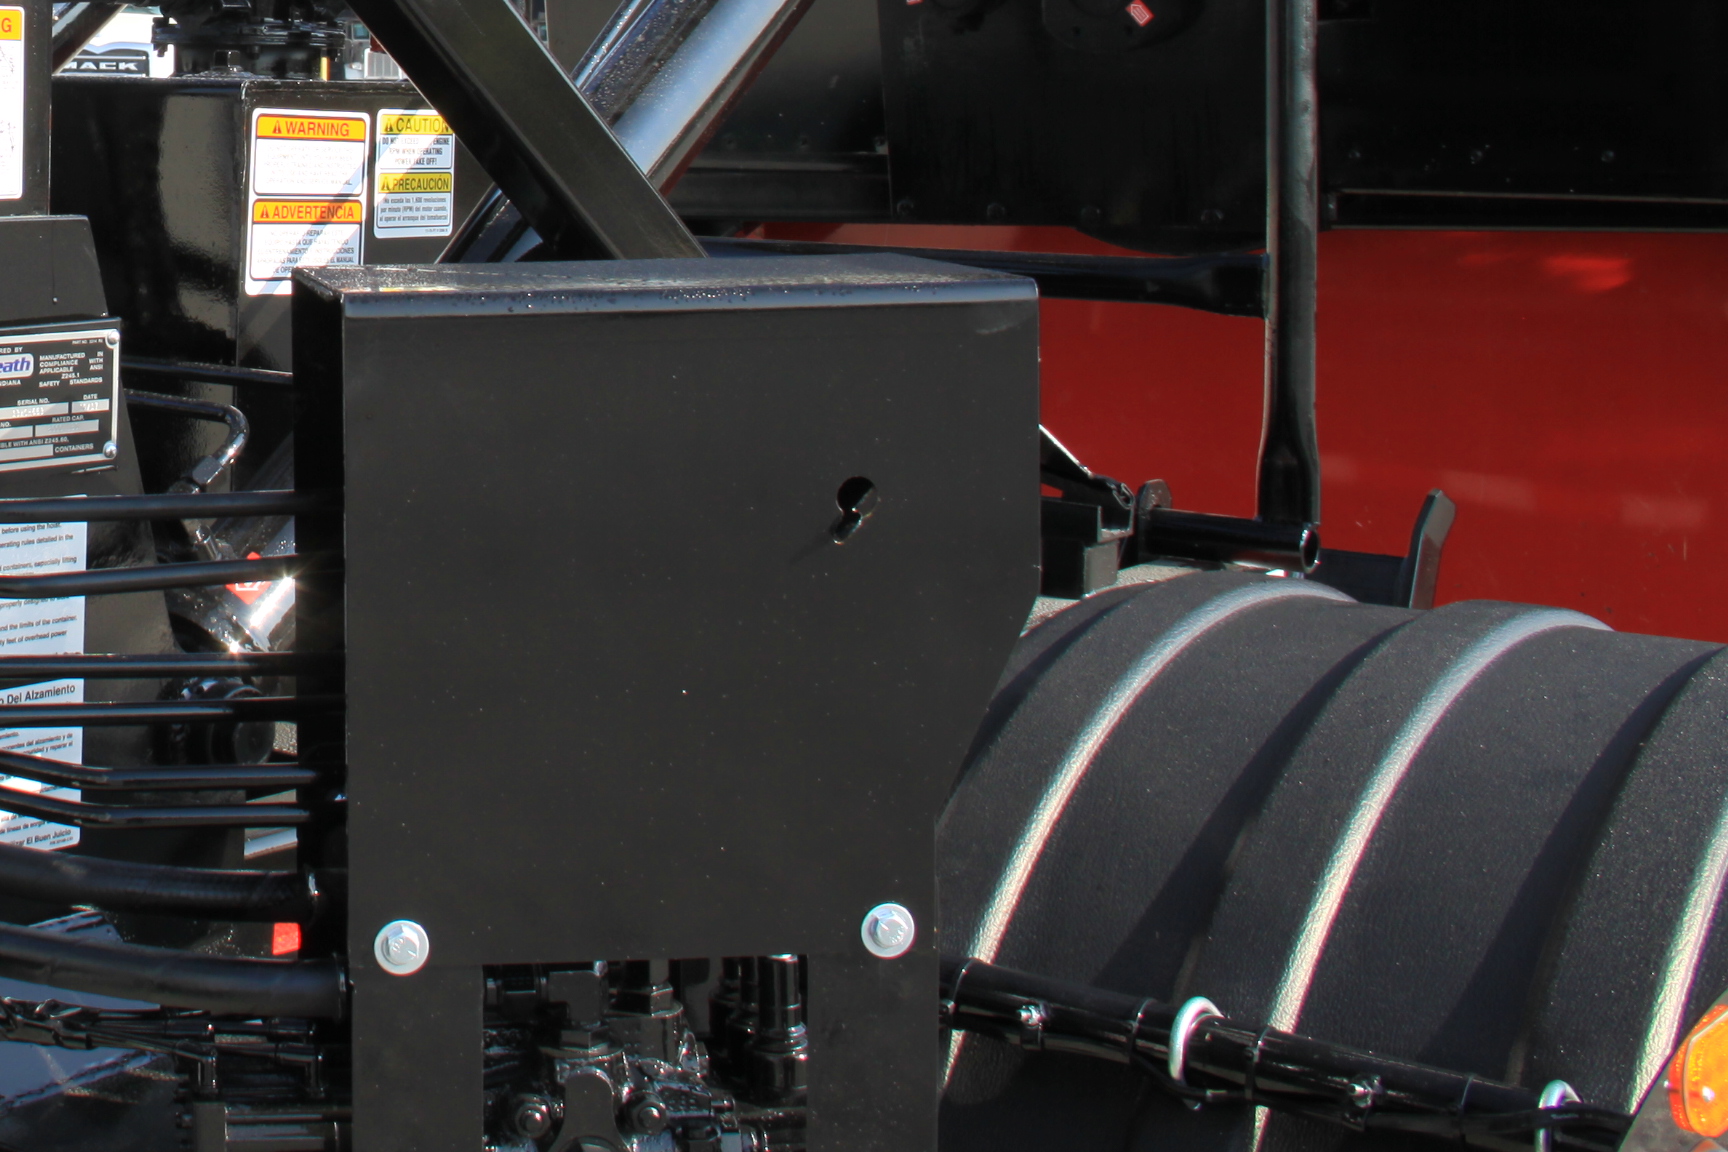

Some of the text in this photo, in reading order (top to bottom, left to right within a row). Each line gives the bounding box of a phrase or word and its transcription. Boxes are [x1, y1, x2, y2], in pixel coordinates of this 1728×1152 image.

[285, 121, 350, 137] WARNING
[393, 174, 449, 191] PRECAUCIÓN
[273, 205, 354, 219] ADVERTENCIA
[39, 352, 86, 361] MANUFACTURED
[39, 359, 78, 367] COMPLIANCE
[39, 366, 74, 374] APPLICABLE
[69, 377, 103, 385] STANDARDS
[17, 398, 38, 406] SERIAL
[55, 443, 94, 452] CONTAINERS
[36, 535, 58, 544] detailed
[24, 632, 49, 642] overhead
[51, 630, 68, 639] power
[7, 692, 22, 704] Del
[25, 684, 76, 701] Alzamiento
[34, 833, 51, 843] Buen
[52, 829, 71, 839] Juicio
